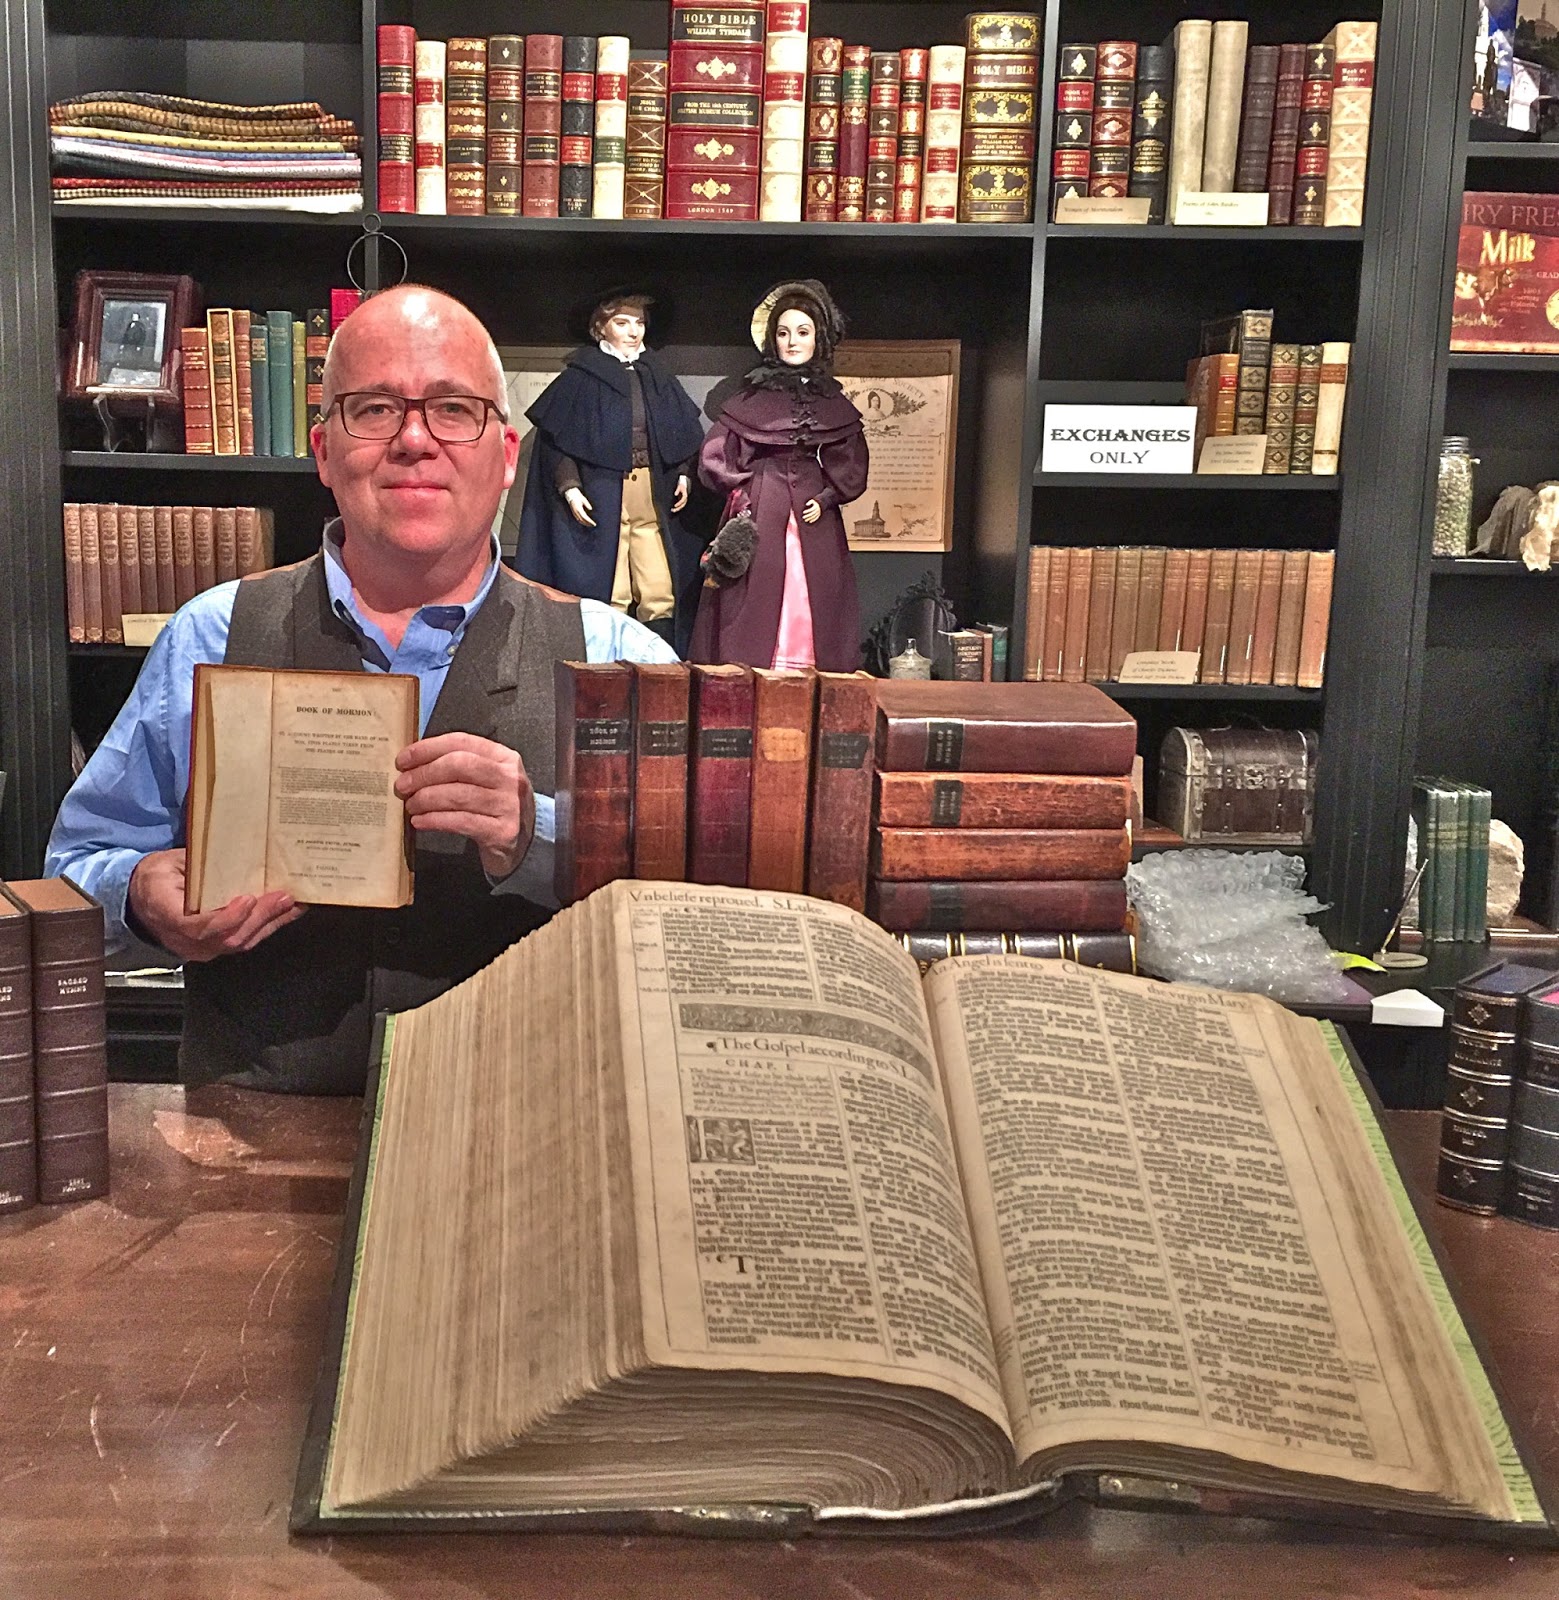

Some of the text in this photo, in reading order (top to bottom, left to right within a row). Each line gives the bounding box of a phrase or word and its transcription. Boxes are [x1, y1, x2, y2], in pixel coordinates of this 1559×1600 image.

[682, 13, 757, 25] HOLY BIBLE
[686, 27, 716, 36] WILLIAM
[973, 65, 1035, 76] HOLY BIBLE
[1511, 205, 1559, 227] FRE
[1479, 229, 1536, 266] Milk
[1050, 428, 1191, 442] EXCHANGES
[1089, 450, 1150, 465] ONLY
[296, 706, 318, 714] BOOK
[336, 708, 372, 716] MORMON
[948, 955, 990, 972] Angel
[716, 1037, 751, 1050] The
[807, 1044, 875, 1071] according
